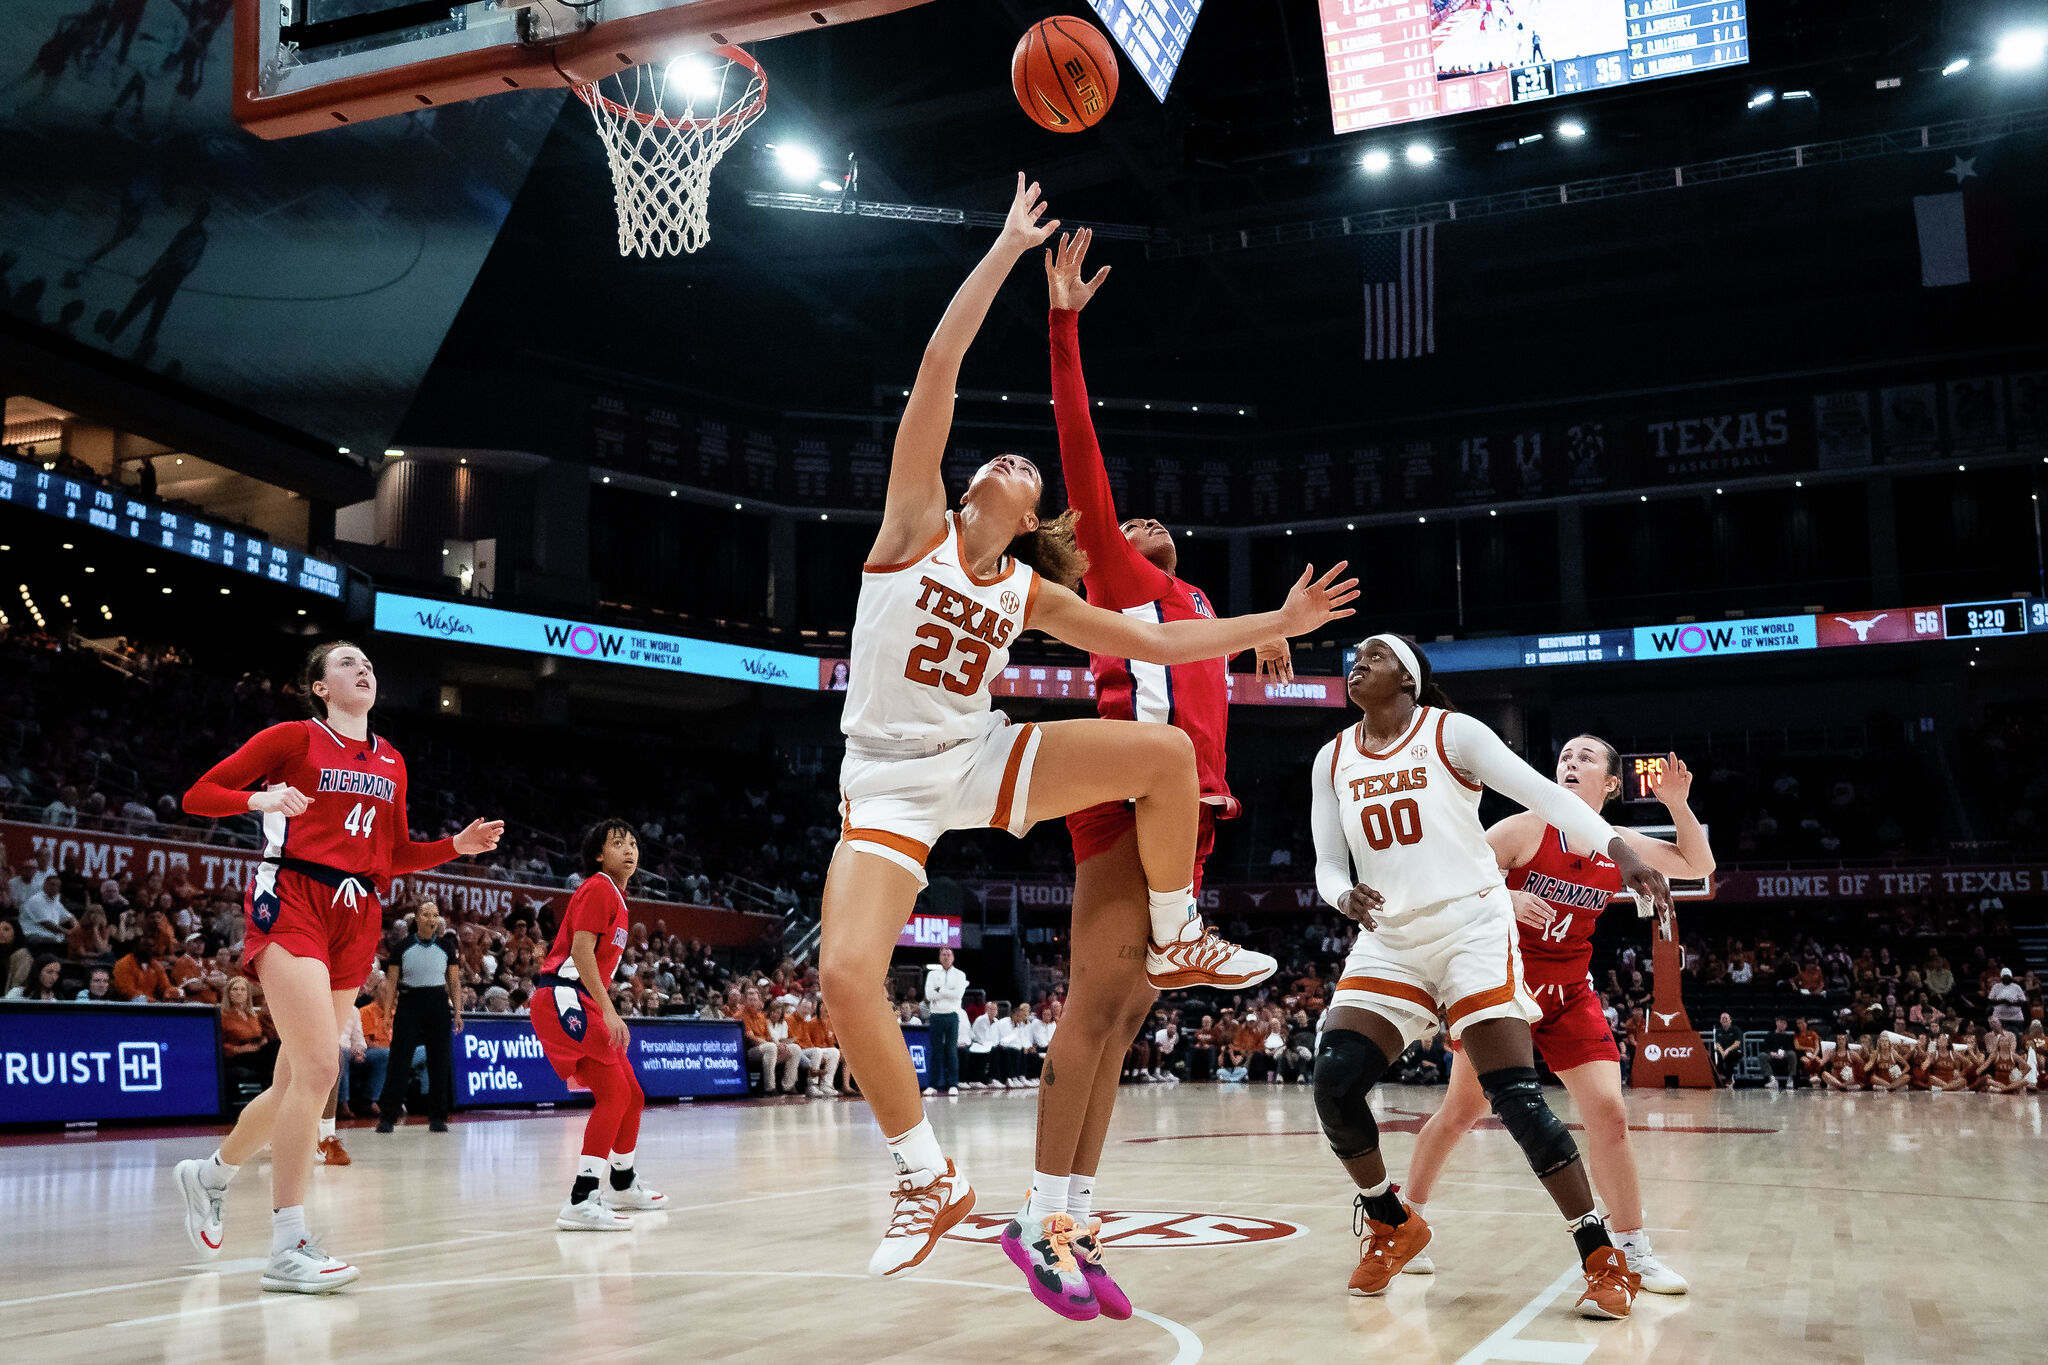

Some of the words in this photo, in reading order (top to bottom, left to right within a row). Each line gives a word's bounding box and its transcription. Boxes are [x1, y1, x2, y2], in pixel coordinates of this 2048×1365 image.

[1064, 57, 1100, 115] ELITE
[1446, 83, 1471, 110] 56
[1517, 70, 1546, 93] 3:21
[1595, 56, 1622, 83] 35
[1648, 409, 1790, 458] TEXAS
[1667, 455, 1773, 473] BASKETBALL
[915, 575, 1014, 649] TEXAS
[1000, 591, 1020, 614] SEC
[415, 607, 474, 635] WinStar
[1741, 625, 1759, 636] THE
[1760, 623, 1795, 635] WORLD
[1913, 611, 1938, 634] 56
[1967, 609, 2005, 629] 3:20
[631, 637, 648, 649] THE
[650, 640, 680, 653] WORLD
[1617, 645, 1624, 657] F
[1741, 637, 1753, 648] OF
[1754, 635, 1799, 648] WINSTAR
[630, 650, 642, 660] OF
[644, 652, 683, 666] WINSTAR
[741, 654, 789, 679] WinStar
[904, 623, 991, 697] 23
[1062, 684, 1069, 696] 2
[317, 768, 396, 804] RICHMON
[1349, 767, 1427, 802] TEXAS
[344, 802, 376, 838] 44
[1361, 798, 1423, 851] 00
[1757, 876, 1829, 897] HOME
[1839, 875, 1870, 895] OF
[1879, 873, 1932, 894] THE
[1942, 871, 2031, 892] TEXAS
[1541, 913, 1573, 942] 14
[464, 1034, 499, 1063] Pay
[502, 1034, 544, 1058] with
[640, 1040, 684, 1053] Personalize
[686, 1042, 702, 1054] your
[703, 1040, 721, 1053] debit
[721, 1041, 738, 1054] card
[1663, 1047, 1693, 1058] razr
[0, 1051, 111, 1085] RUIST
[643, 1057, 661, 1070] with
[661, 1057, 684, 1070] Truist
[704, 1057, 738, 1071] Checking
[468, 1065, 522, 1096] pride.
